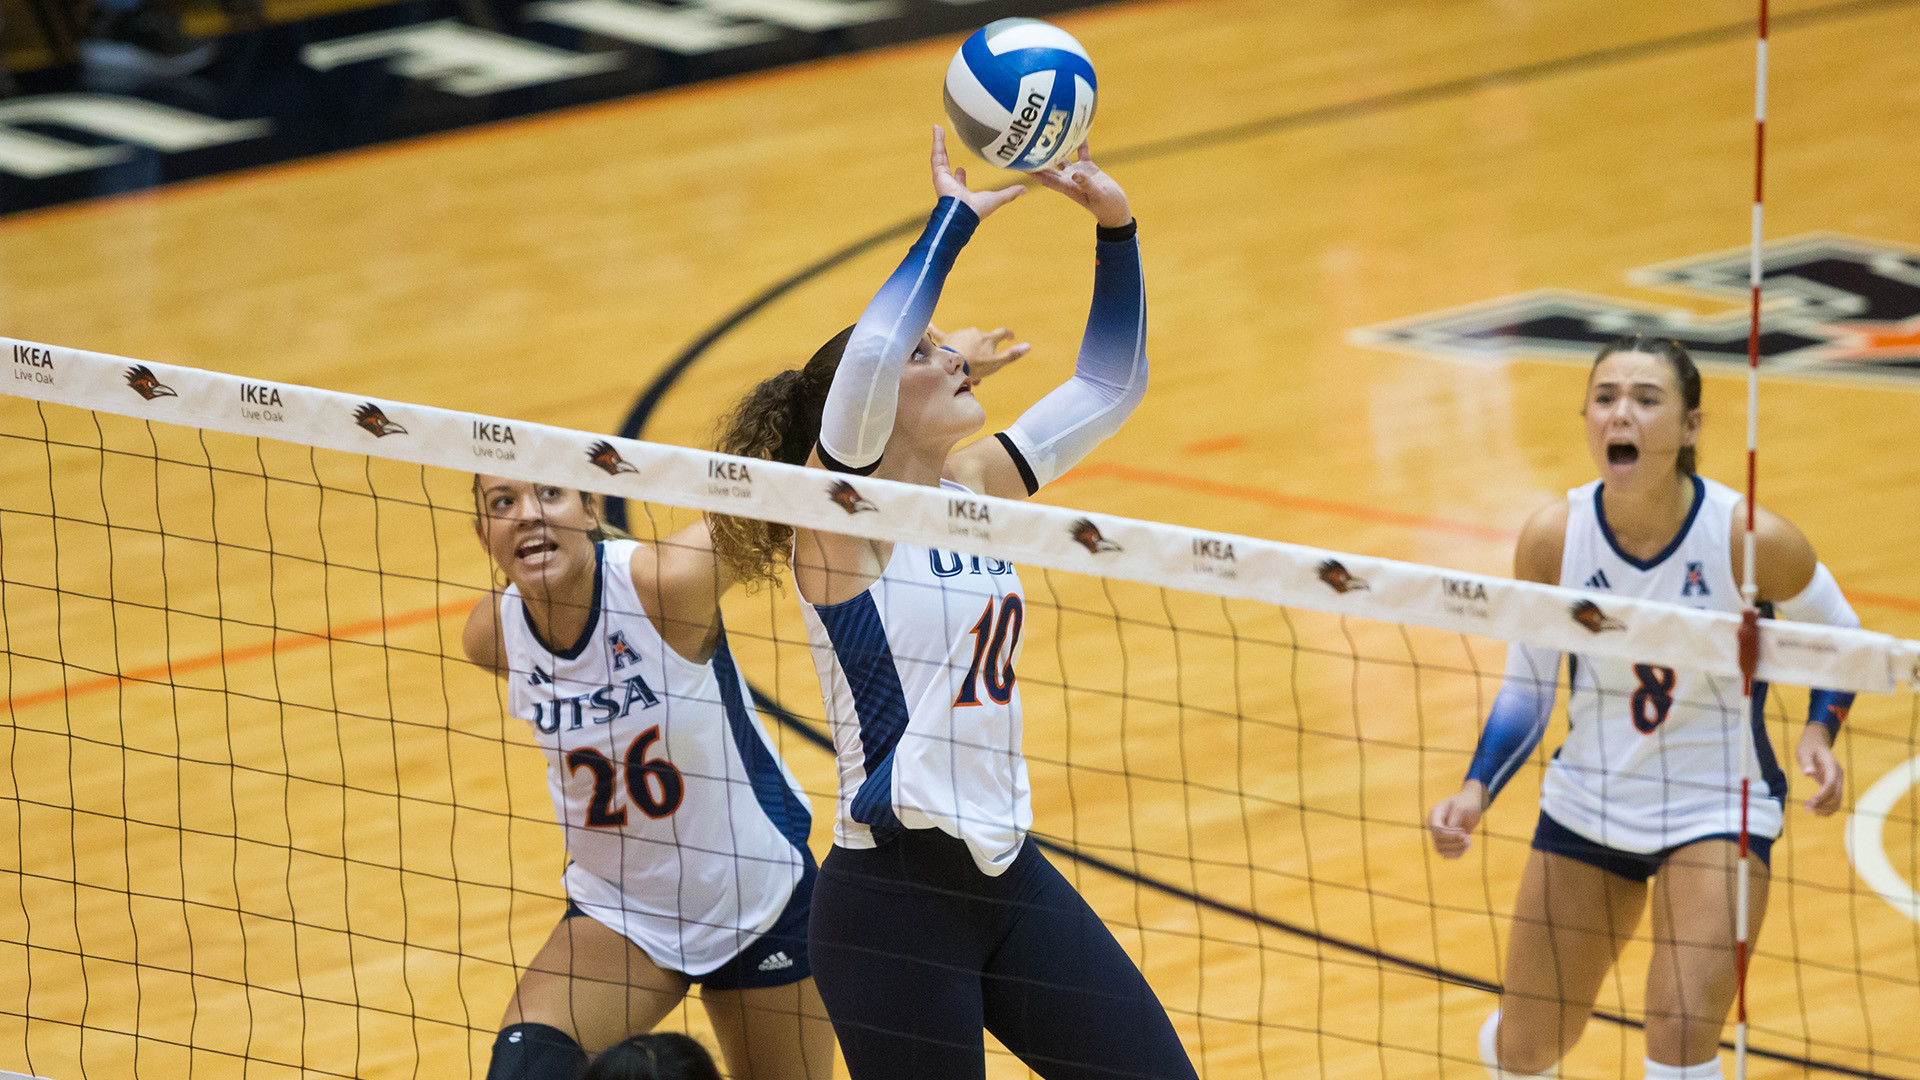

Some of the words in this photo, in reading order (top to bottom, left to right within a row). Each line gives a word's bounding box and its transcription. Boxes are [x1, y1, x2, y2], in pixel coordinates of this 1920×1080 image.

[996, 91, 1046, 162] molten
[1023, 109, 1071, 165] NCAA
[13, 344, 54, 370] IKEA
[14, 368, 33, 382] Live
[36, 371, 55, 385] Oak
[240, 383, 283, 408] IKEA
[241, 407, 261, 420] Live
[263, 410, 284, 423] Oak
[472, 420, 516, 446] IKEA
[473, 445, 493, 457] Live
[495, 448, 516, 460] Oak
[708, 459, 752, 483] IKEA
[708, 484, 729, 497] Live
[732, 486, 752, 499] Oak
[947, 499, 991, 524] IKEA
[1192, 538, 1236, 561] IKEA
[1442, 577, 1488, 602] IKEA
[953, 592, 1023, 708] 10
[533, 675, 660, 735] UTSA
[1630, 662, 1676, 734] 8
[565, 724, 684, 828] 26
